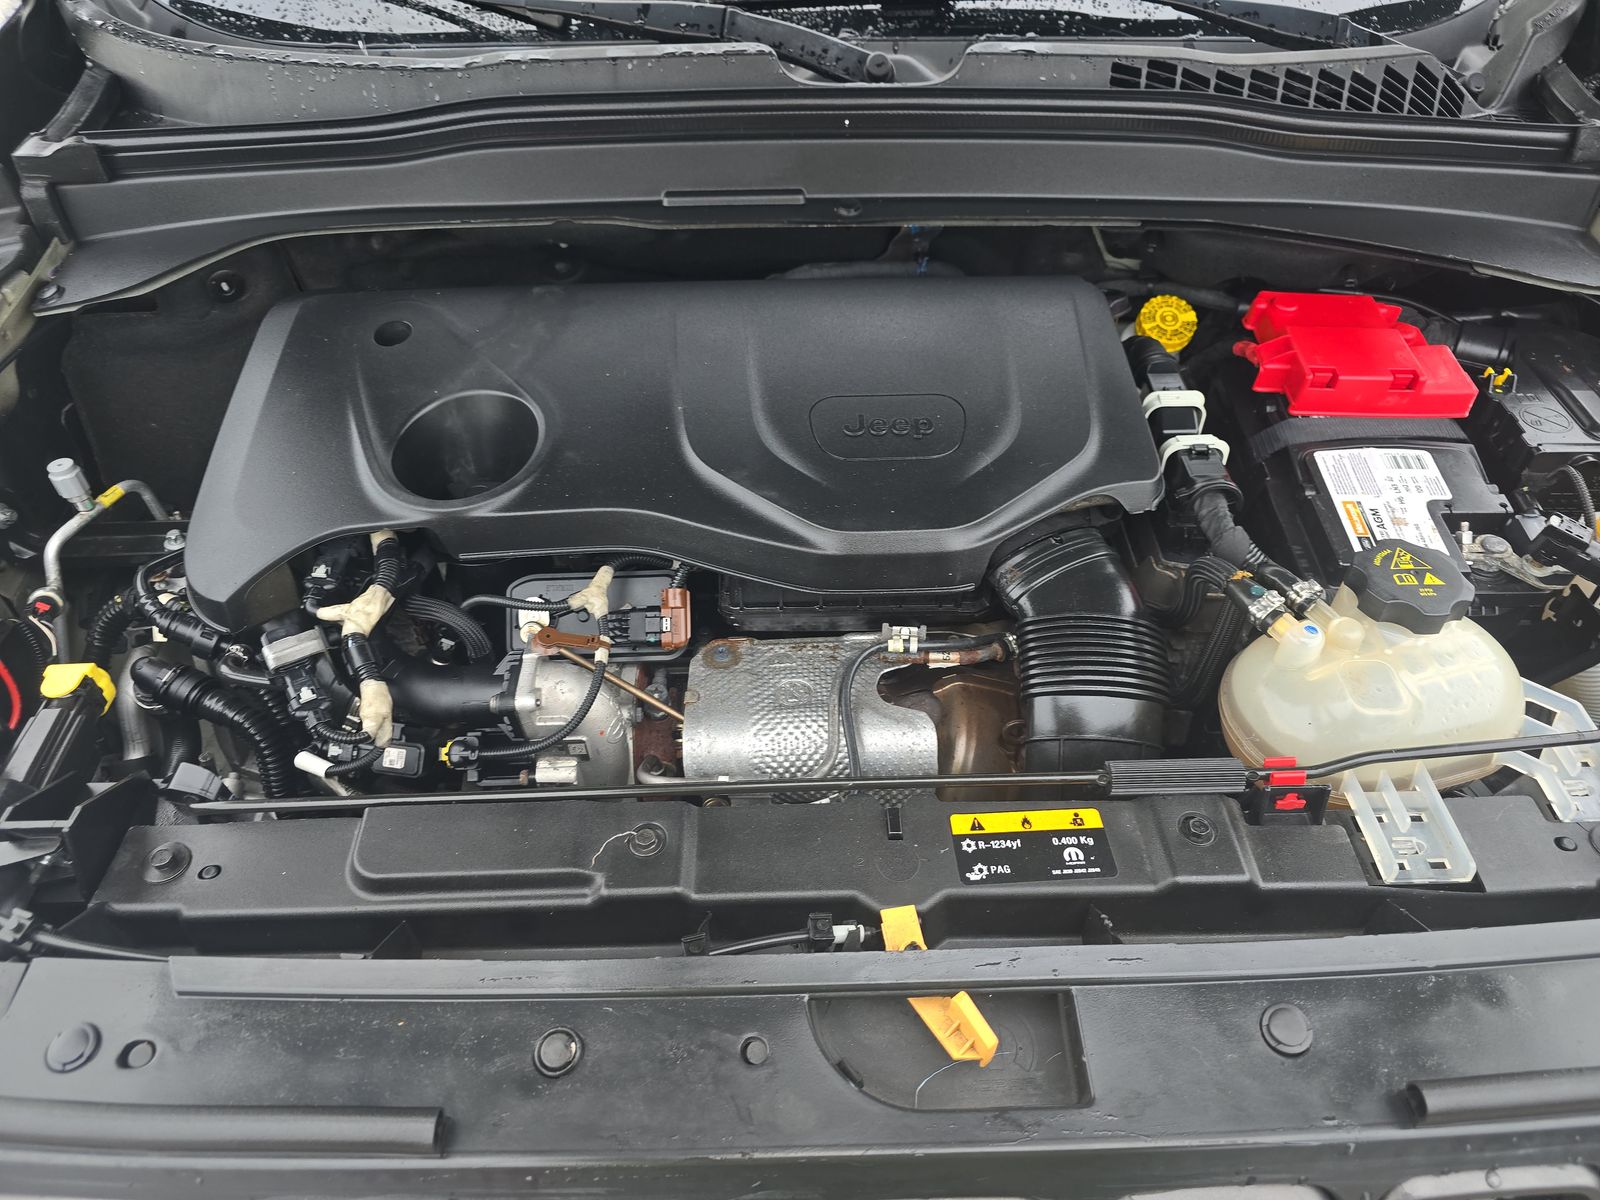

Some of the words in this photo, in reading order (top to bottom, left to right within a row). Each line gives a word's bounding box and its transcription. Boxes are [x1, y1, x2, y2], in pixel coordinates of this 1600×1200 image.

[843, 414, 935, 439] Jeep
[1368, 507, 1387, 530] AGM
[1051, 836, 1078, 846] 0.400
[1080, 835, 1094, 846] Kg
[990, 864, 1011, 875] PAG
